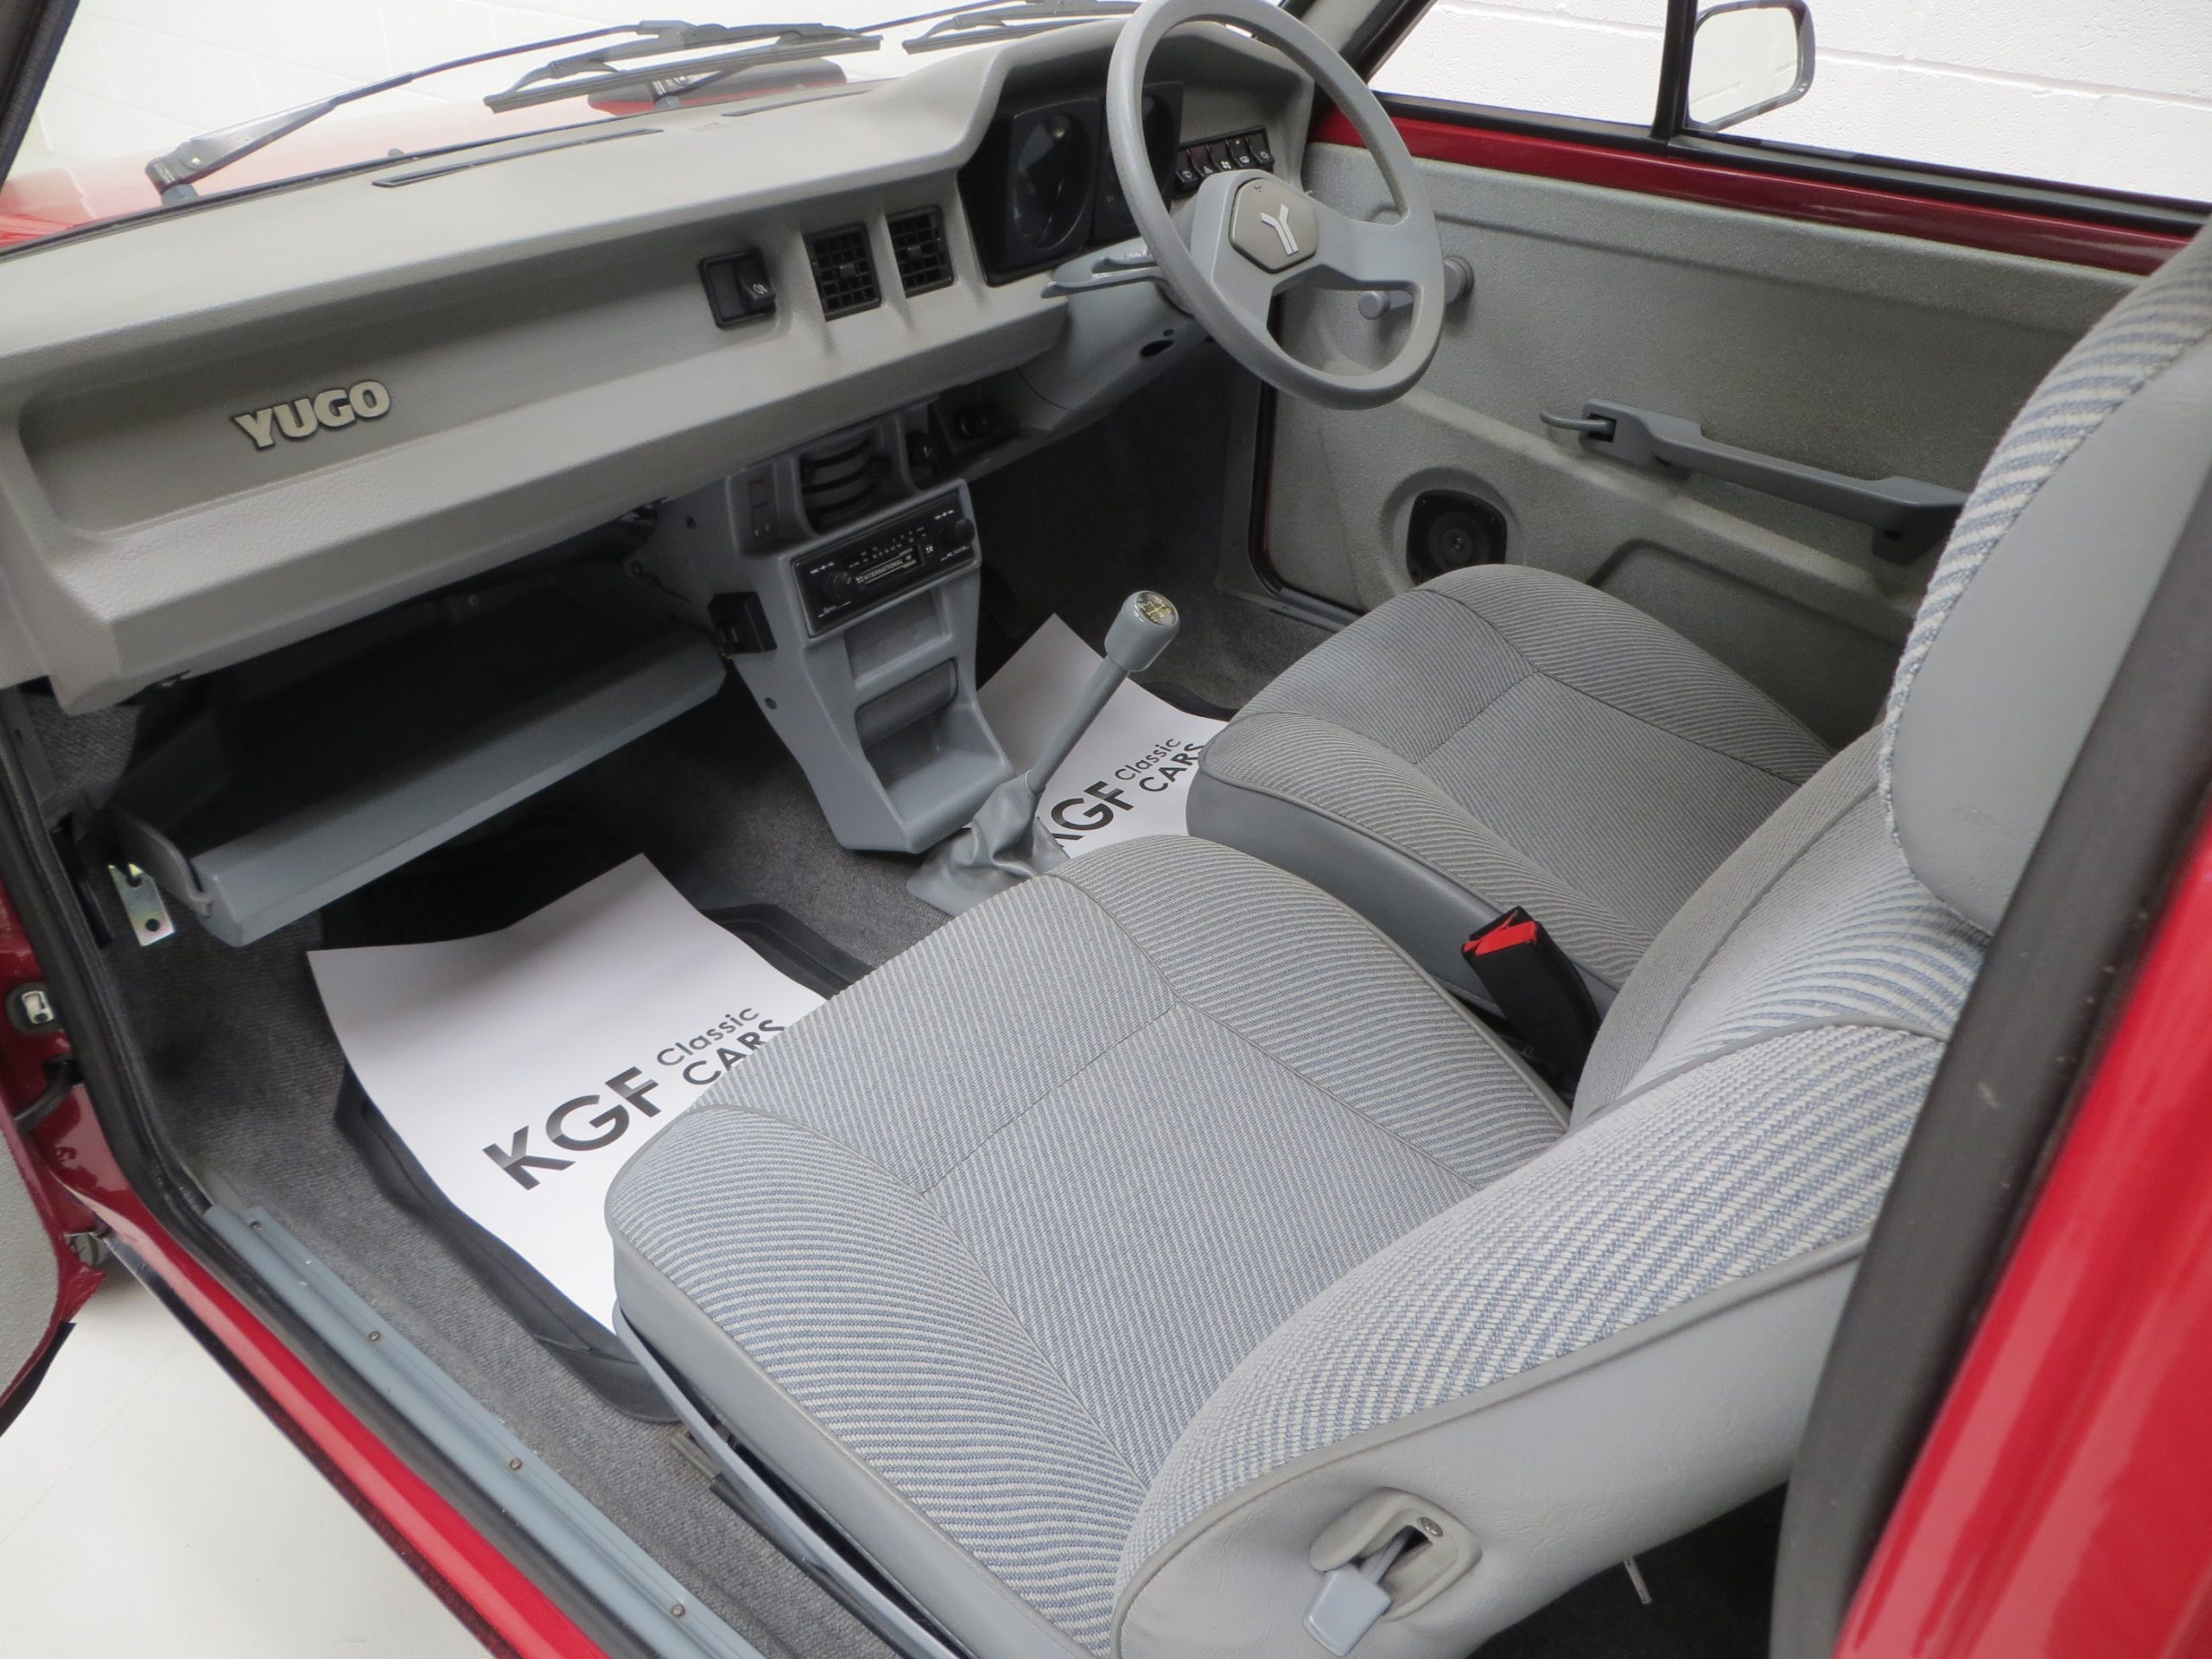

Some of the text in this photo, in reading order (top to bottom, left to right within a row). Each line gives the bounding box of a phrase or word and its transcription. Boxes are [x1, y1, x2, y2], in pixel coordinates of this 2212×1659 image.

[232, 380, 391, 449] YUGO
[1115, 738, 1182, 780] Classic
[657, 1008, 760, 1066] Classic
[482, 1066, 662, 1191] KGF
